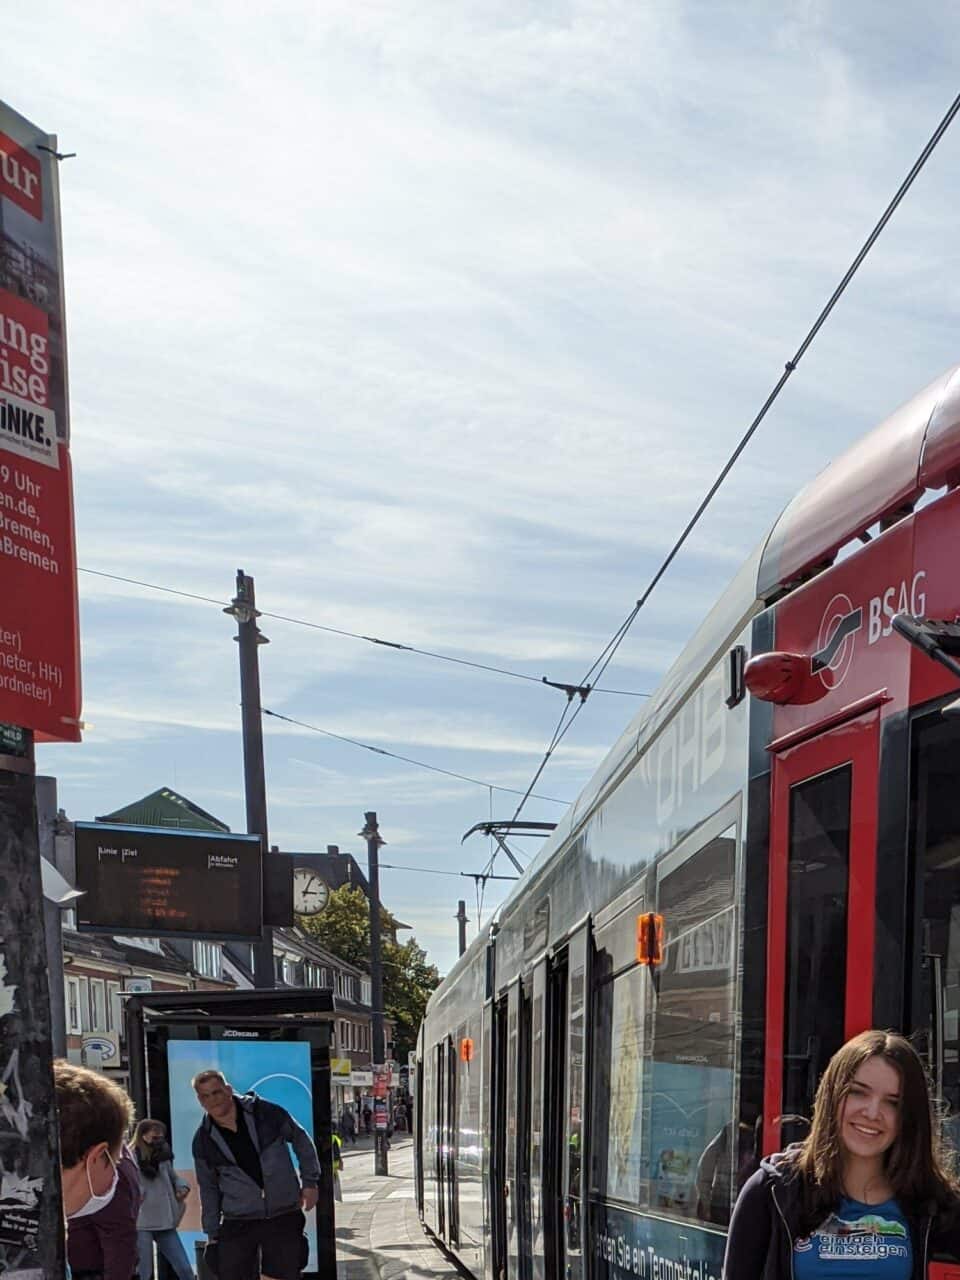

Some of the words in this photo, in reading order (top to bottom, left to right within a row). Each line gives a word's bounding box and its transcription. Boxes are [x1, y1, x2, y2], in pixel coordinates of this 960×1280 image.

[14, 470, 42, 498] Uhr
[0, 534, 59, 575] Bremen
[868, 570, 926, 646] BSAG
[39, 661, 63, 689] HH)
[617, 1235, 631, 1271] Sie
[632, 1240, 646, 1278] ein
[818, 1242, 907, 1258] einsteigen
